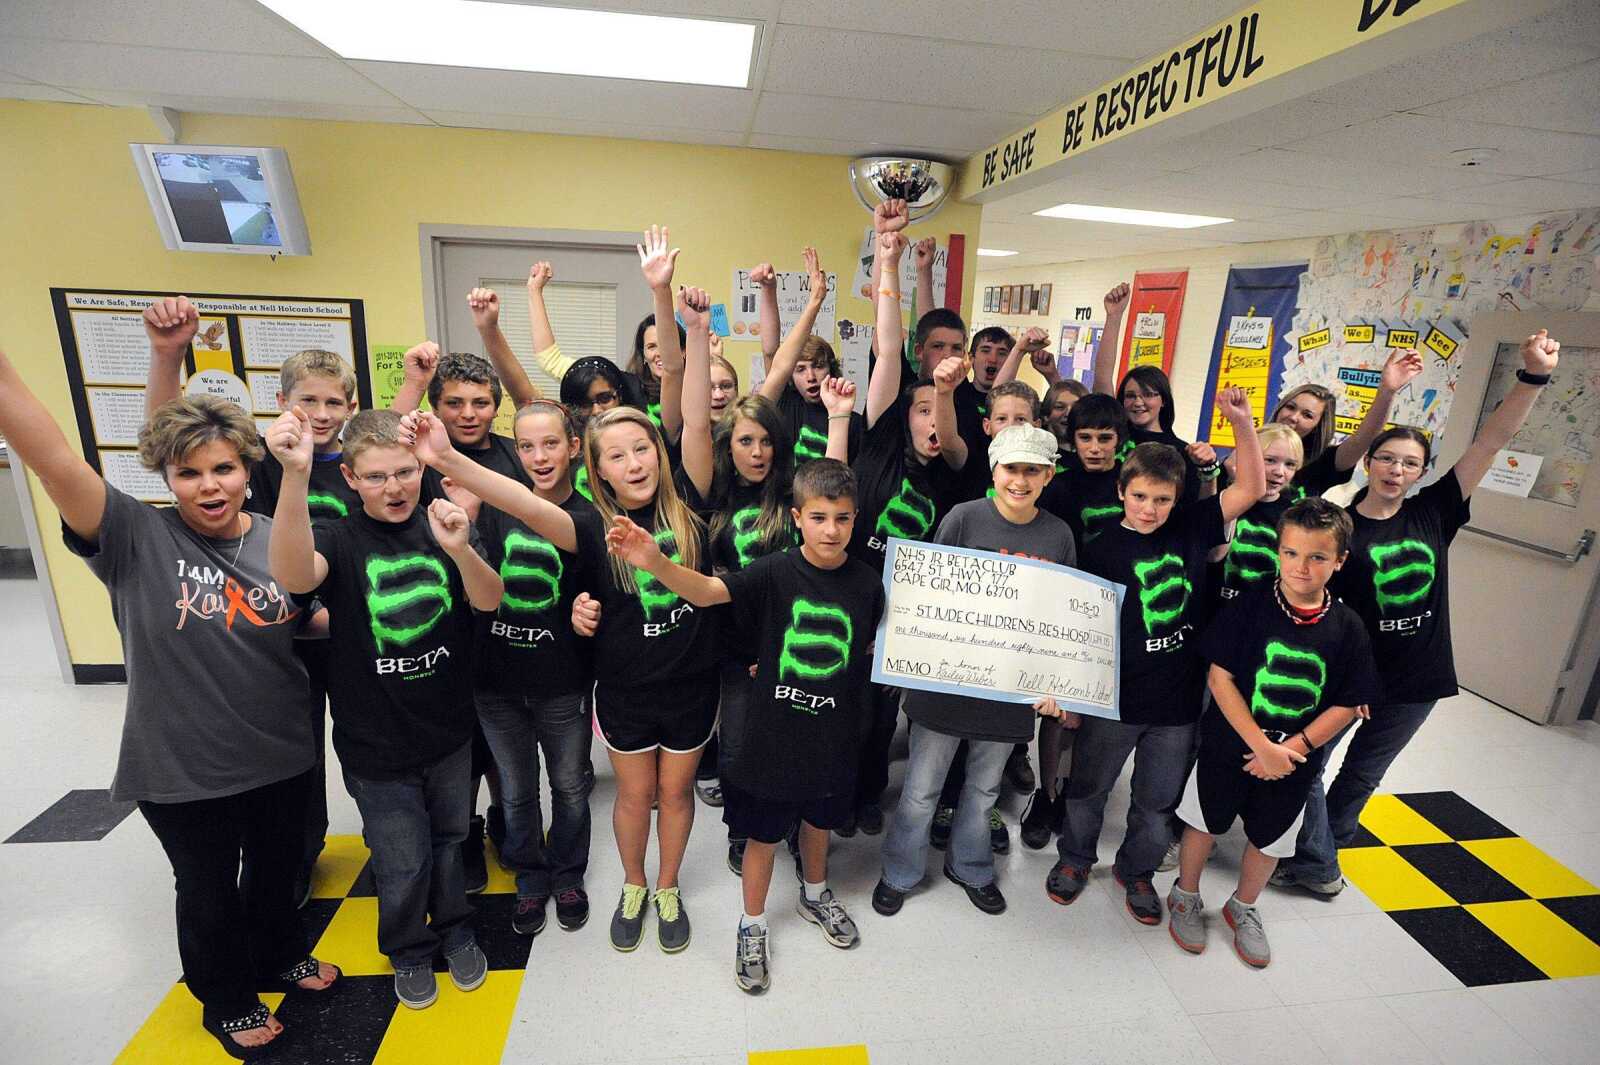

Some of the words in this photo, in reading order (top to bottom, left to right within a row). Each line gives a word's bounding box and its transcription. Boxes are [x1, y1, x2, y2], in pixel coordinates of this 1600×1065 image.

[982, 147, 998, 188] BE
[1001, 128, 1036, 181] SAFE
[1062, 102, 1087, 154] BE
[1091, 12, 1264, 141] RESPECTFUL
[90, 298, 104, 306] Are
[107, 299, 128, 307] Safe,
[198, 302, 247, 311] Responsible
[1076, 307, 1092, 320] PTO
[1302, 332, 1328, 348] What
[1347, 328, 1362, 338] We
[1391, 334, 1416, 344] NHS
[1431, 332, 1451, 352] See
[376, 362, 392, 371] For
[896, 546, 926, 561] NHS
[947, 554, 980, 570] BETA
[982, 560, 1017, 576] CLUB
[188, 565, 226, 585] AM
[894, 558, 924, 573] 6547
[928, 564, 945, 577] ST
[950, 566, 986, 582] HWY
[992, 573, 1009, 586] 177
[893, 571, 927, 587] CAPE
[956, 580, 982, 596] MO
[986, 584, 1020, 600] 63701
[1100, 588, 1116, 604] 1001
[916, 604, 933, 618] ST
[935, 606, 964, 623] JUDE
[1069, 598, 1100, 617] 10-15-12
[490, 620, 555, 642] BETA
[376, 646, 450, 676] BETA
[1061, 650, 1078, 659] and
[886, 657, 931, 676] MEMO
[1016, 670, 1044, 689] Nell
[774, 684, 836, 709] BETA
